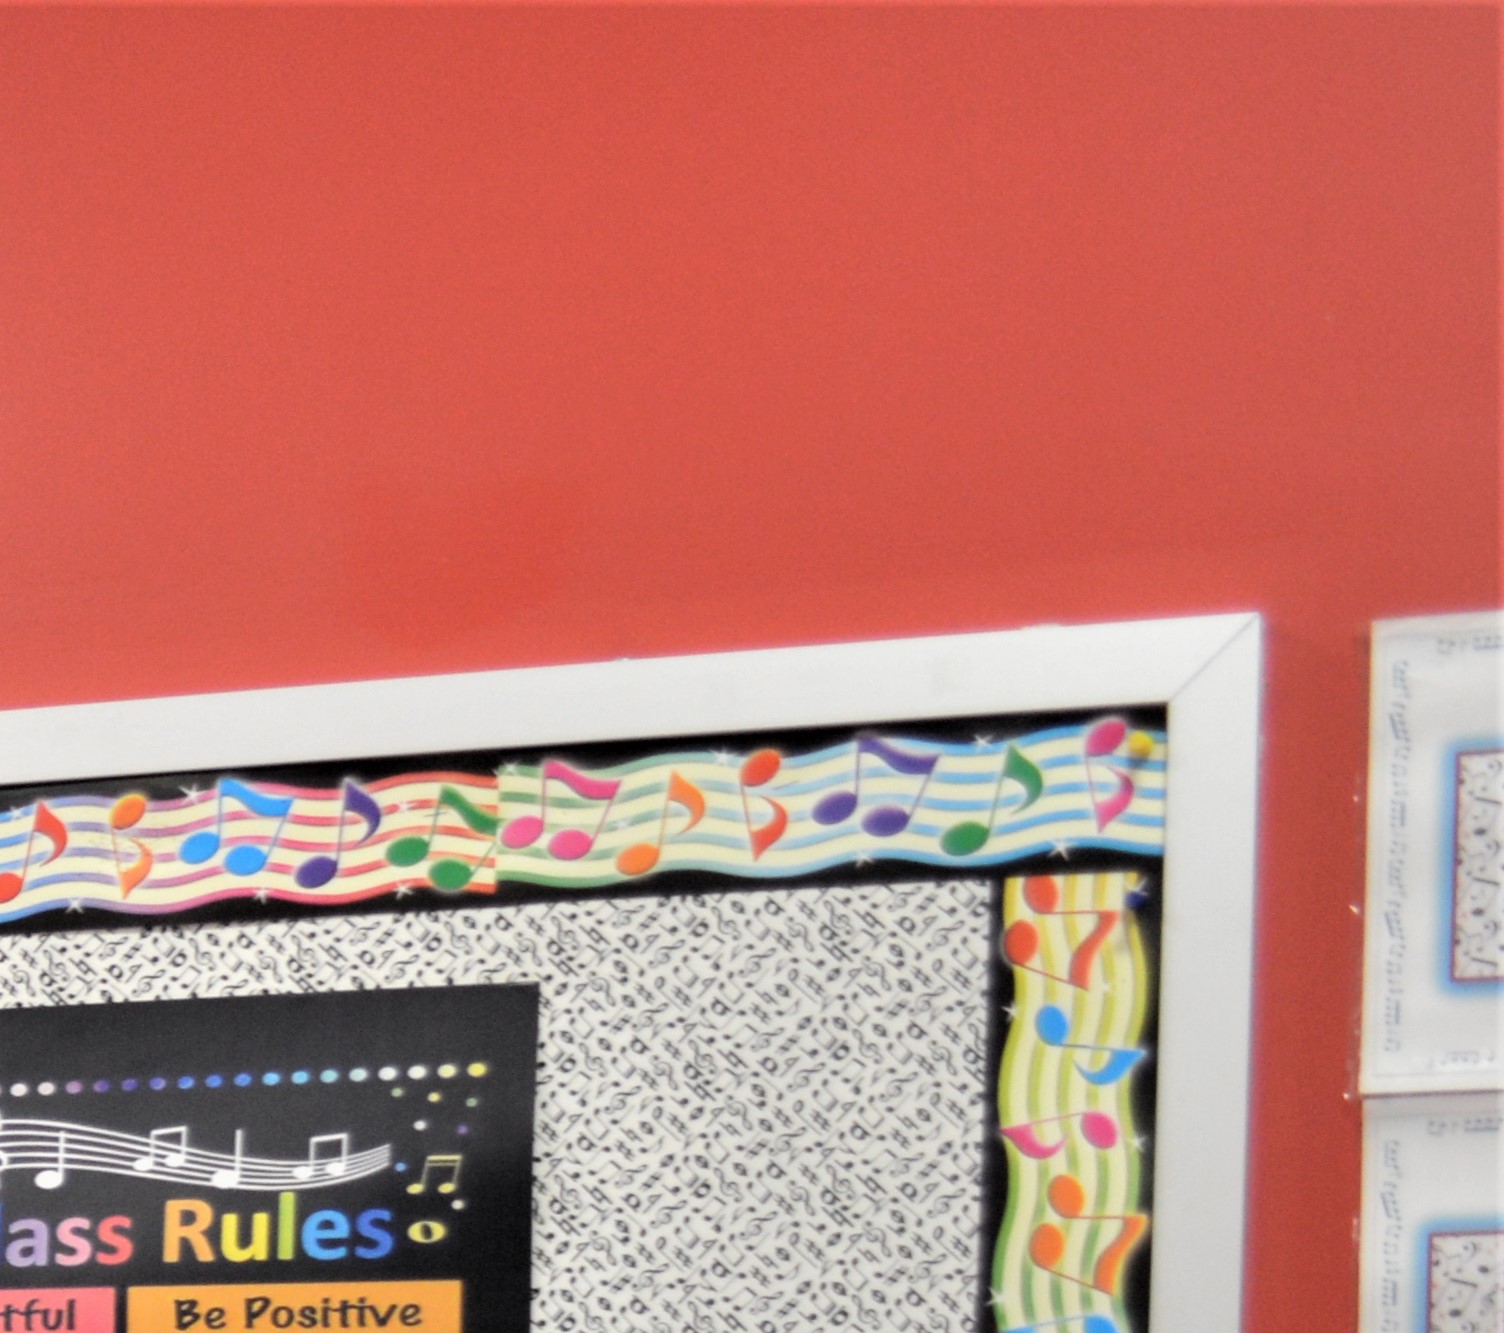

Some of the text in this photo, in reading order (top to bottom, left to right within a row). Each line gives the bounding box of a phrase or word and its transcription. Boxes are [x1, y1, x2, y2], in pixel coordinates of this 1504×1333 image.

[162, 1190, 395, 1264] Rules
[173, 1295, 423, 1330] Be Positive
